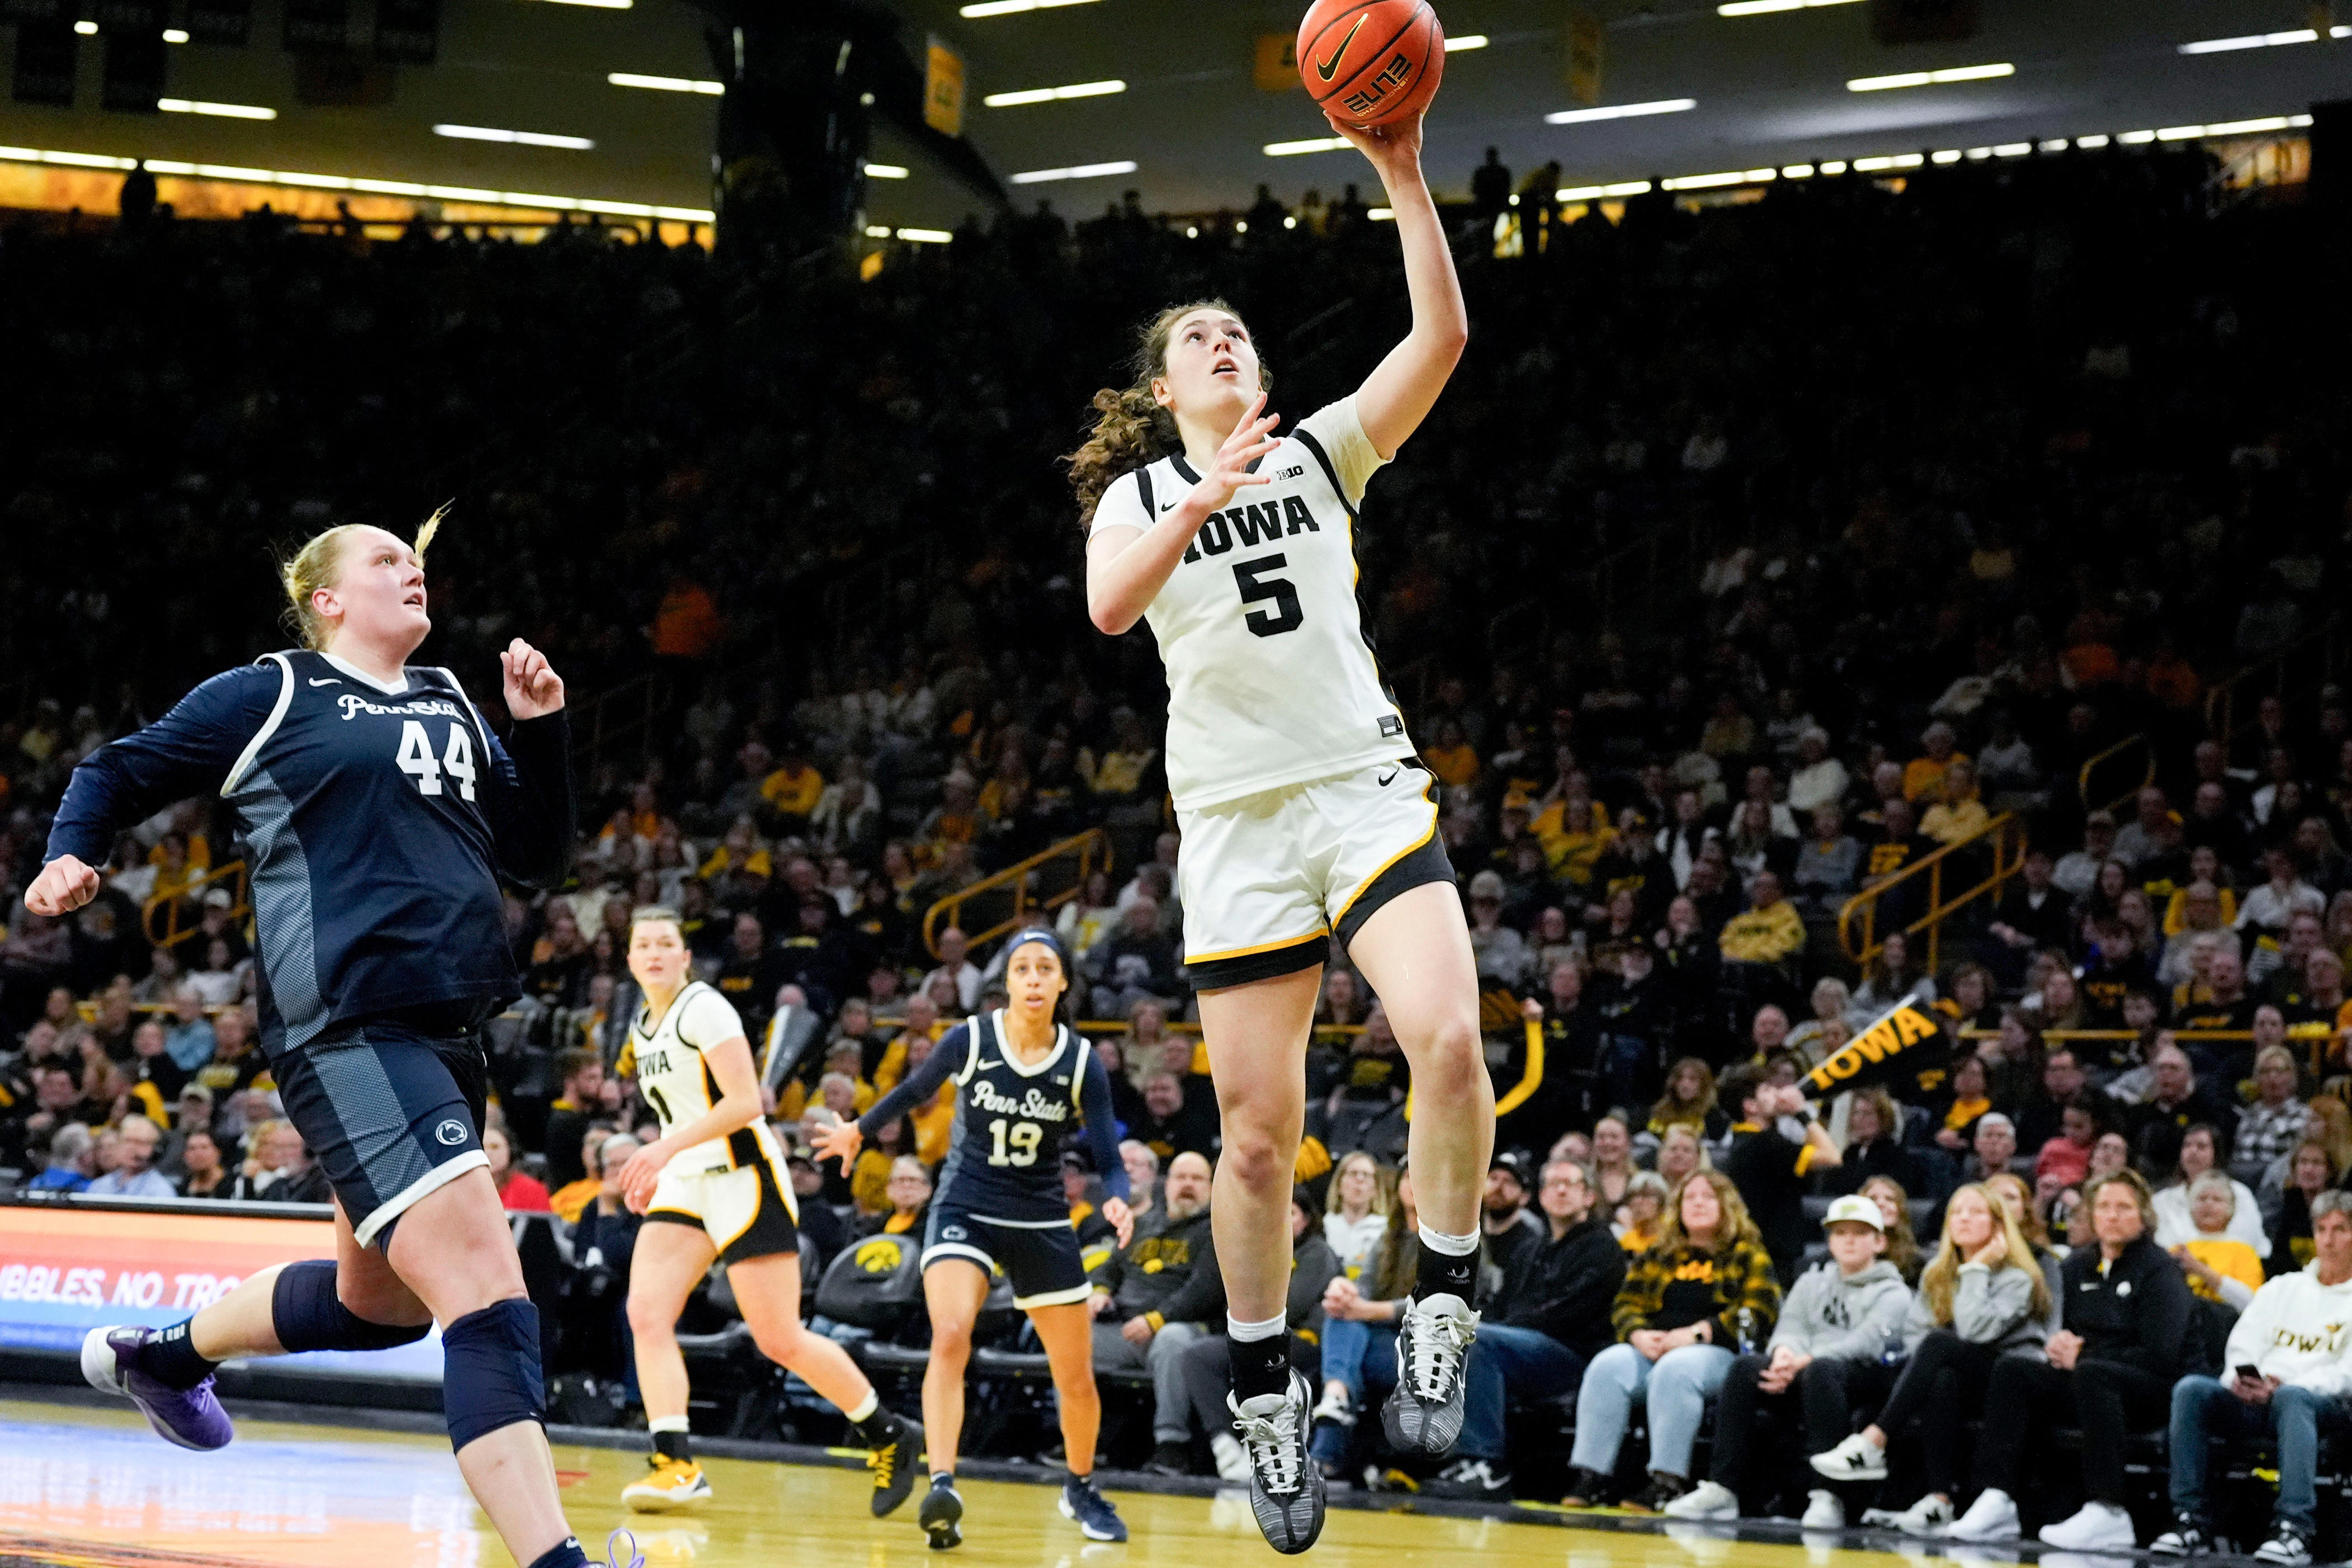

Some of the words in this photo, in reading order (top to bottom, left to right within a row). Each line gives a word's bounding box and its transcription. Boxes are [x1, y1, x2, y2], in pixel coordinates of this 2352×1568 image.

[1342, 53, 1412, 114] ELITE
[1357, 66, 1413, 117] CHAMPIONSH
[1232, 552, 1304, 637] 5
[337, 694, 413, 720] Penn
[395, 720, 475, 802] 44
[1810, 1007, 1938, 1090] IOWA
[650, 1086, 673, 1124] 1
[970, 1080, 1019, 1114] Penn
[988, 1118, 1043, 1167] 19
[111, 1271, 164, 1310] NO
